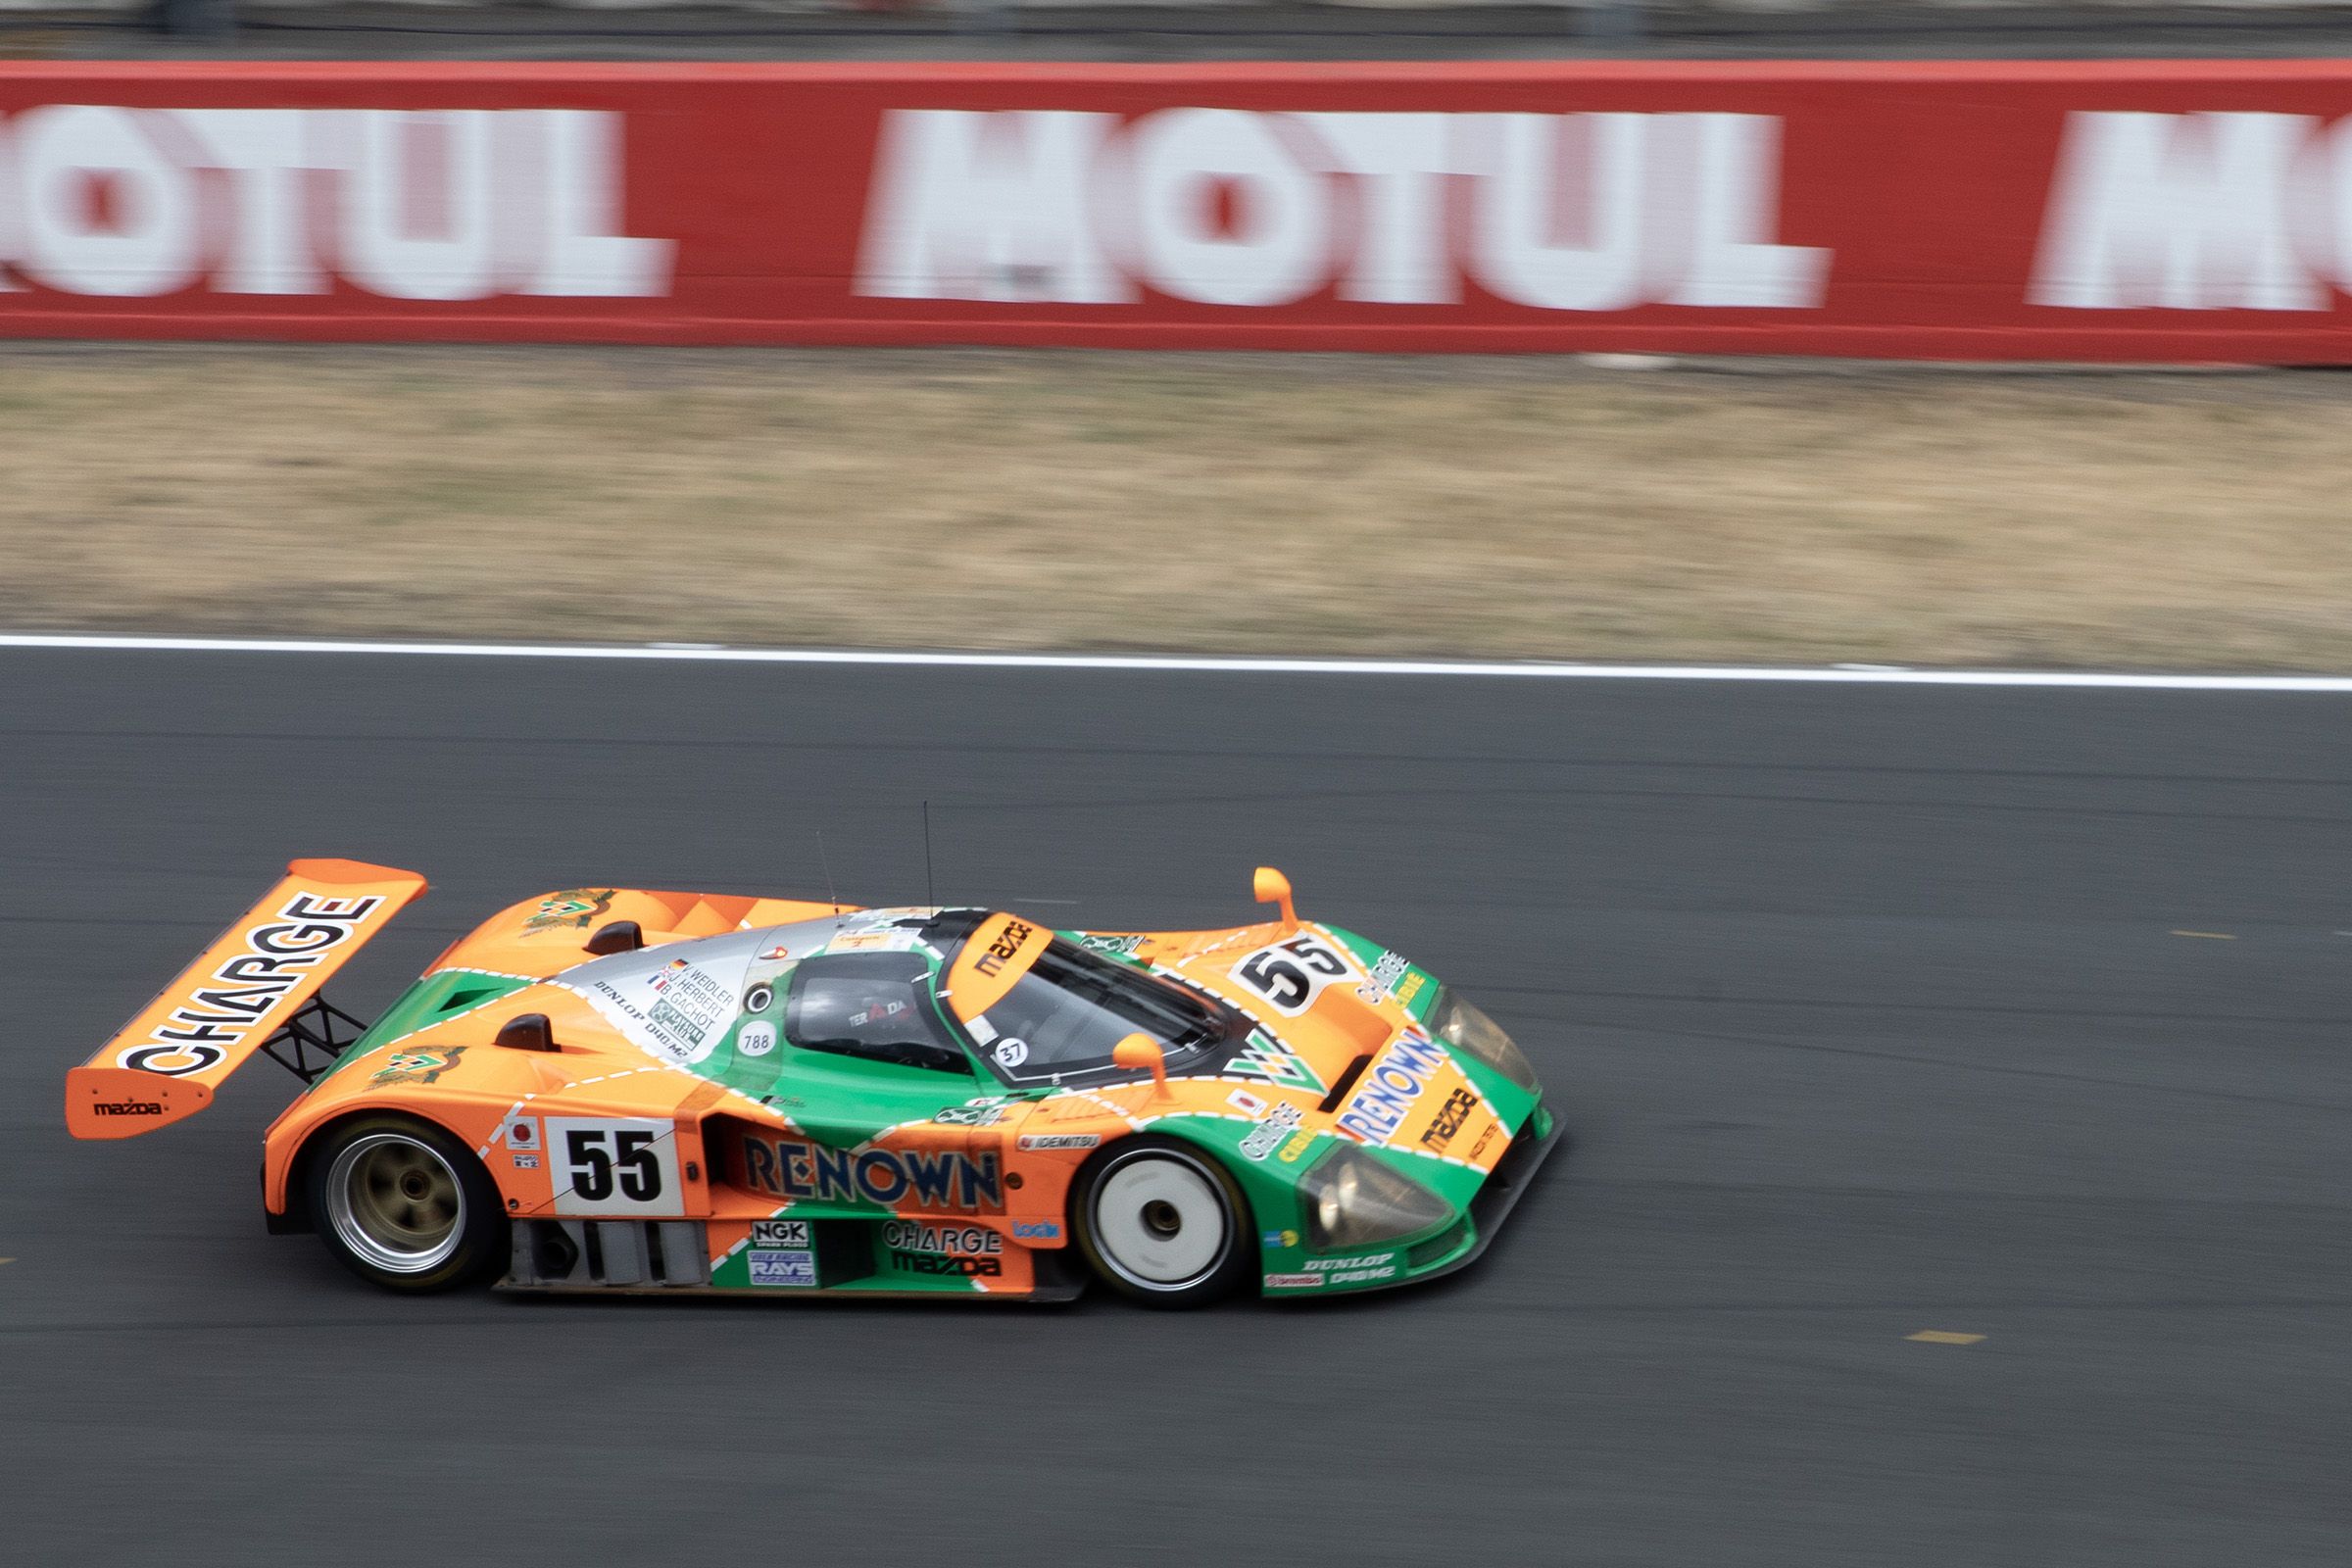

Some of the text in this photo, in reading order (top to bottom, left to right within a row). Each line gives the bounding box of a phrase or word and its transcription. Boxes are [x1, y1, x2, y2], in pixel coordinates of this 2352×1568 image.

[0, 104, 680, 300] OTUL
[850, 108, 1835, 312] MOTUL
[974, 921, 1033, 977] mazda
[1240, 936, 1347, 1008] 55
[117, 892, 386, 1077] CHARGE
[691, 966, 734, 1006] WEIDLER
[594, 981, 688, 1057] DUNLOP D40/M2
[670, 992, 715, 1030] GACHOT
[744, 1035, 769, 1050] 788
[1000, 1042, 1022, 1062] 37
[94, 1102, 162, 1116] mazda
[1337, 1028, 1449, 1149] RENOWN
[1034, 1135, 1098, 1148] IDEMITSU
[1239, 1101, 1304, 1161] CHARGE
[1420, 1088, 1478, 1153] mazda
[565, 1130, 662, 1202] 55
[743, 1136, 1004, 1209] RENOWN
[756, 1222, 807, 1241] NGK
[883, 1220, 1003, 1255] CHARGE
[752, 1261, 812, 1276] RAYS
[892, 1250, 1002, 1277] mazda
[1301, 1253, 1395, 1271] DUNLOP
